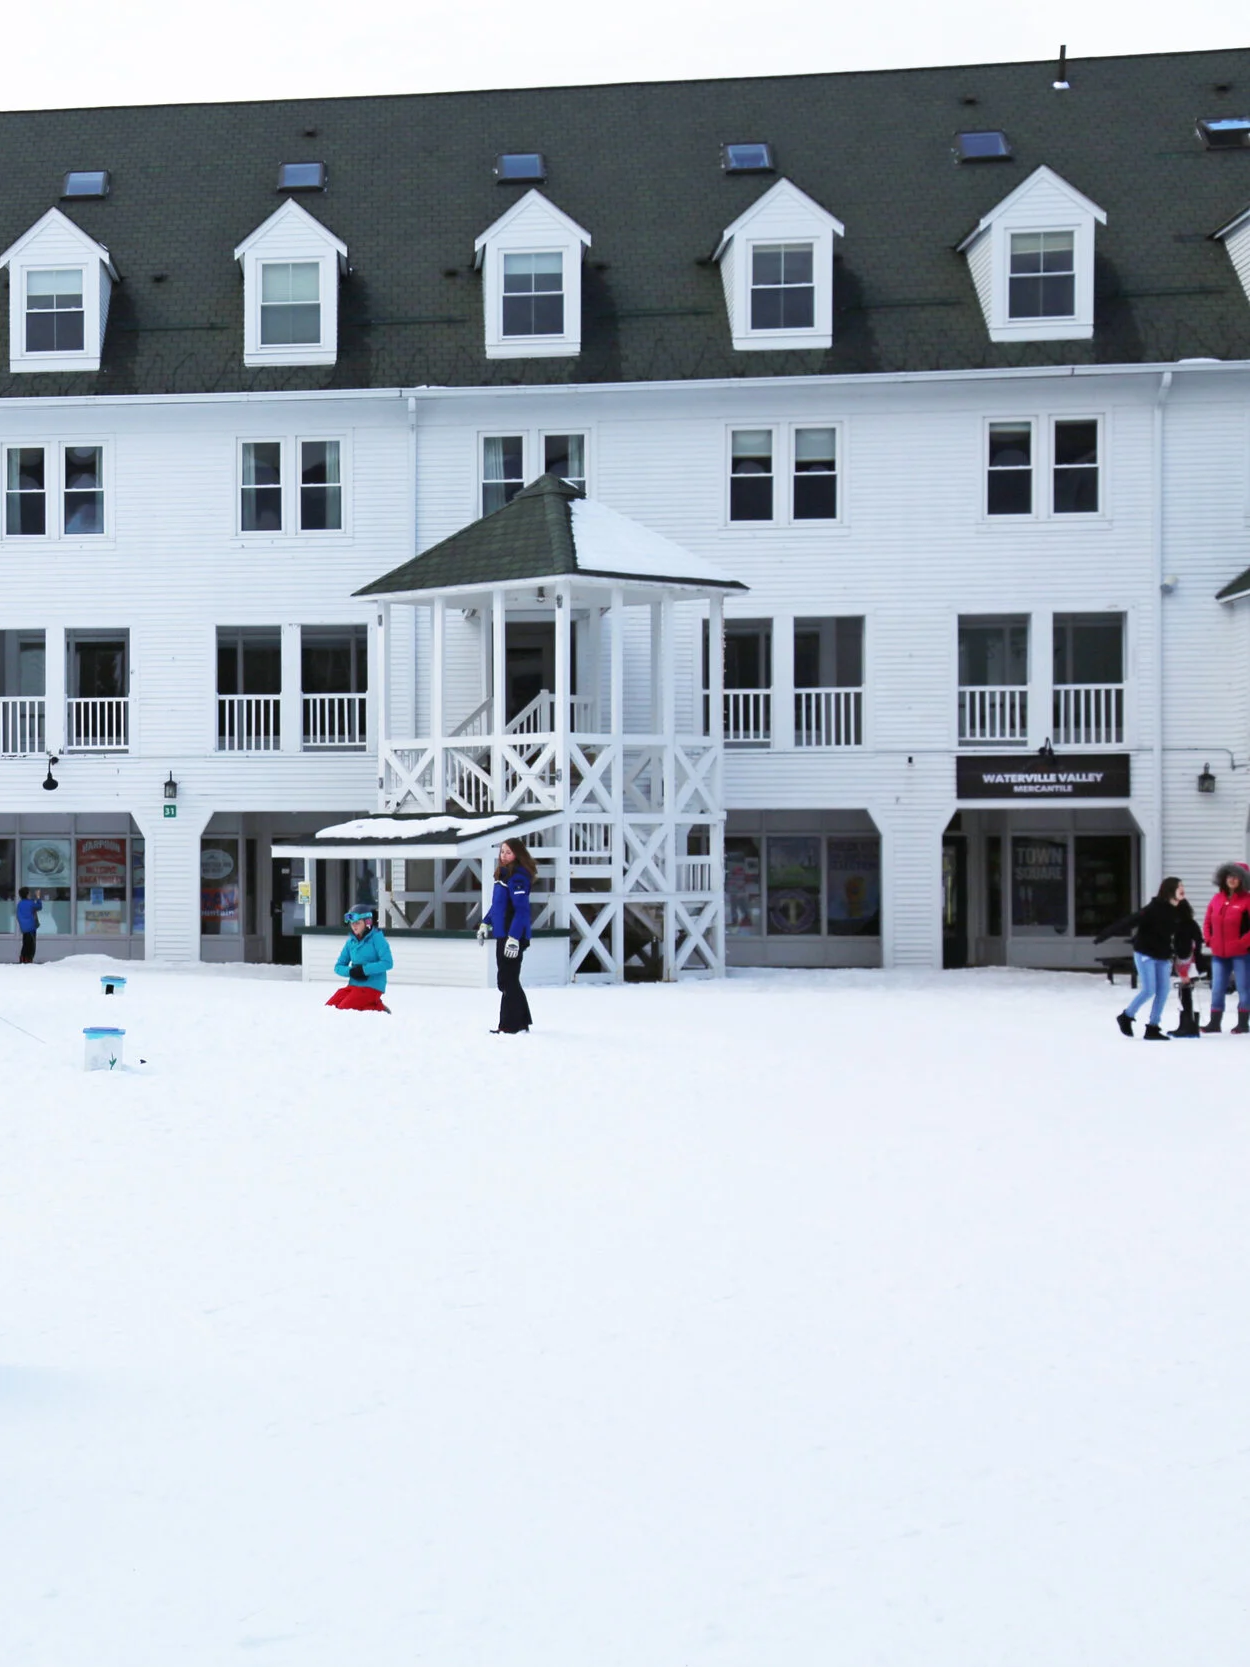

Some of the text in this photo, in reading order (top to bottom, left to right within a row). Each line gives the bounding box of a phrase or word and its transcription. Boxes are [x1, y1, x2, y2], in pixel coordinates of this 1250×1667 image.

[982, 772, 1104, 784] WATERVILLE VALLEY
[1013, 785, 1073, 793] MERCANTILE
[165, 807, 175, 816] 31
[1015, 847, 1063, 865] TOWN
[1015, 866, 1064, 880] SQUARE
